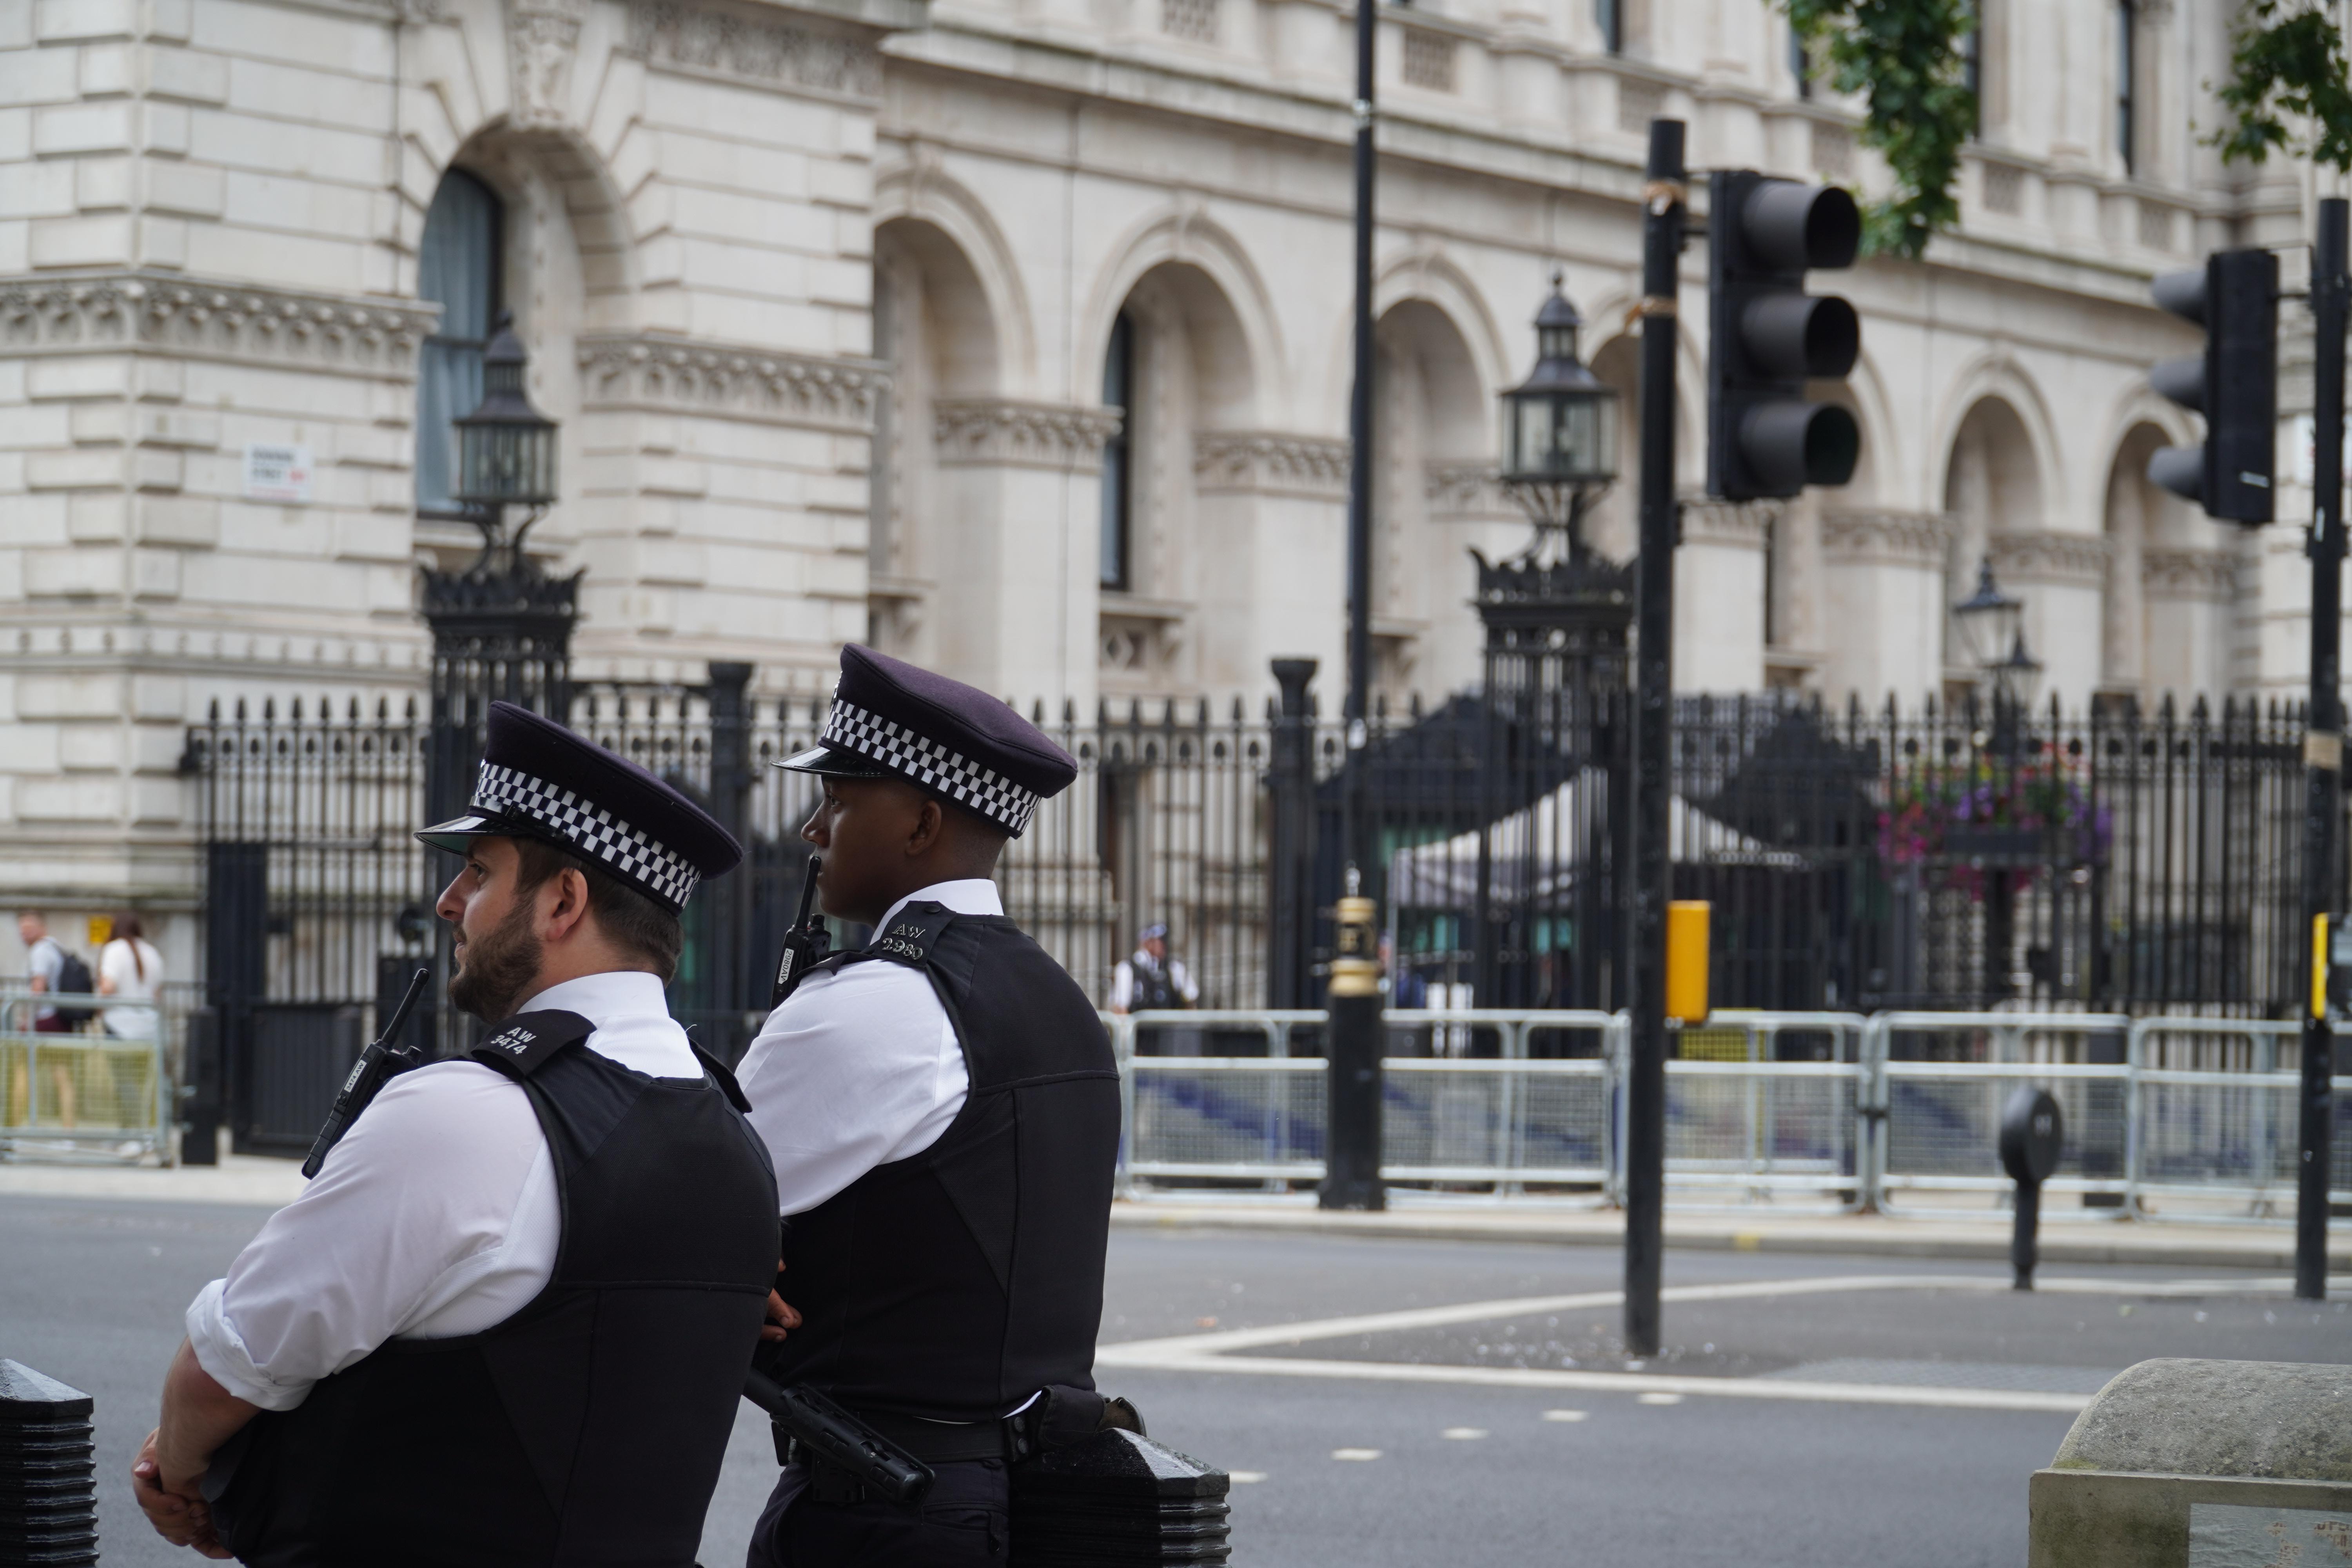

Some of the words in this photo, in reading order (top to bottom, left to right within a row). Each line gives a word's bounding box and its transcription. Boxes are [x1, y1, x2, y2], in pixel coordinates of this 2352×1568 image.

[892, 923, 926, 939] AW
[882, 937, 923, 960] 2980
[506, 1027, 537, 1042] AW
[490, 1035, 527, 1054] 3474
[347, 1075, 356, 1090] 3474
[356, 1062, 363, 1074] AW
